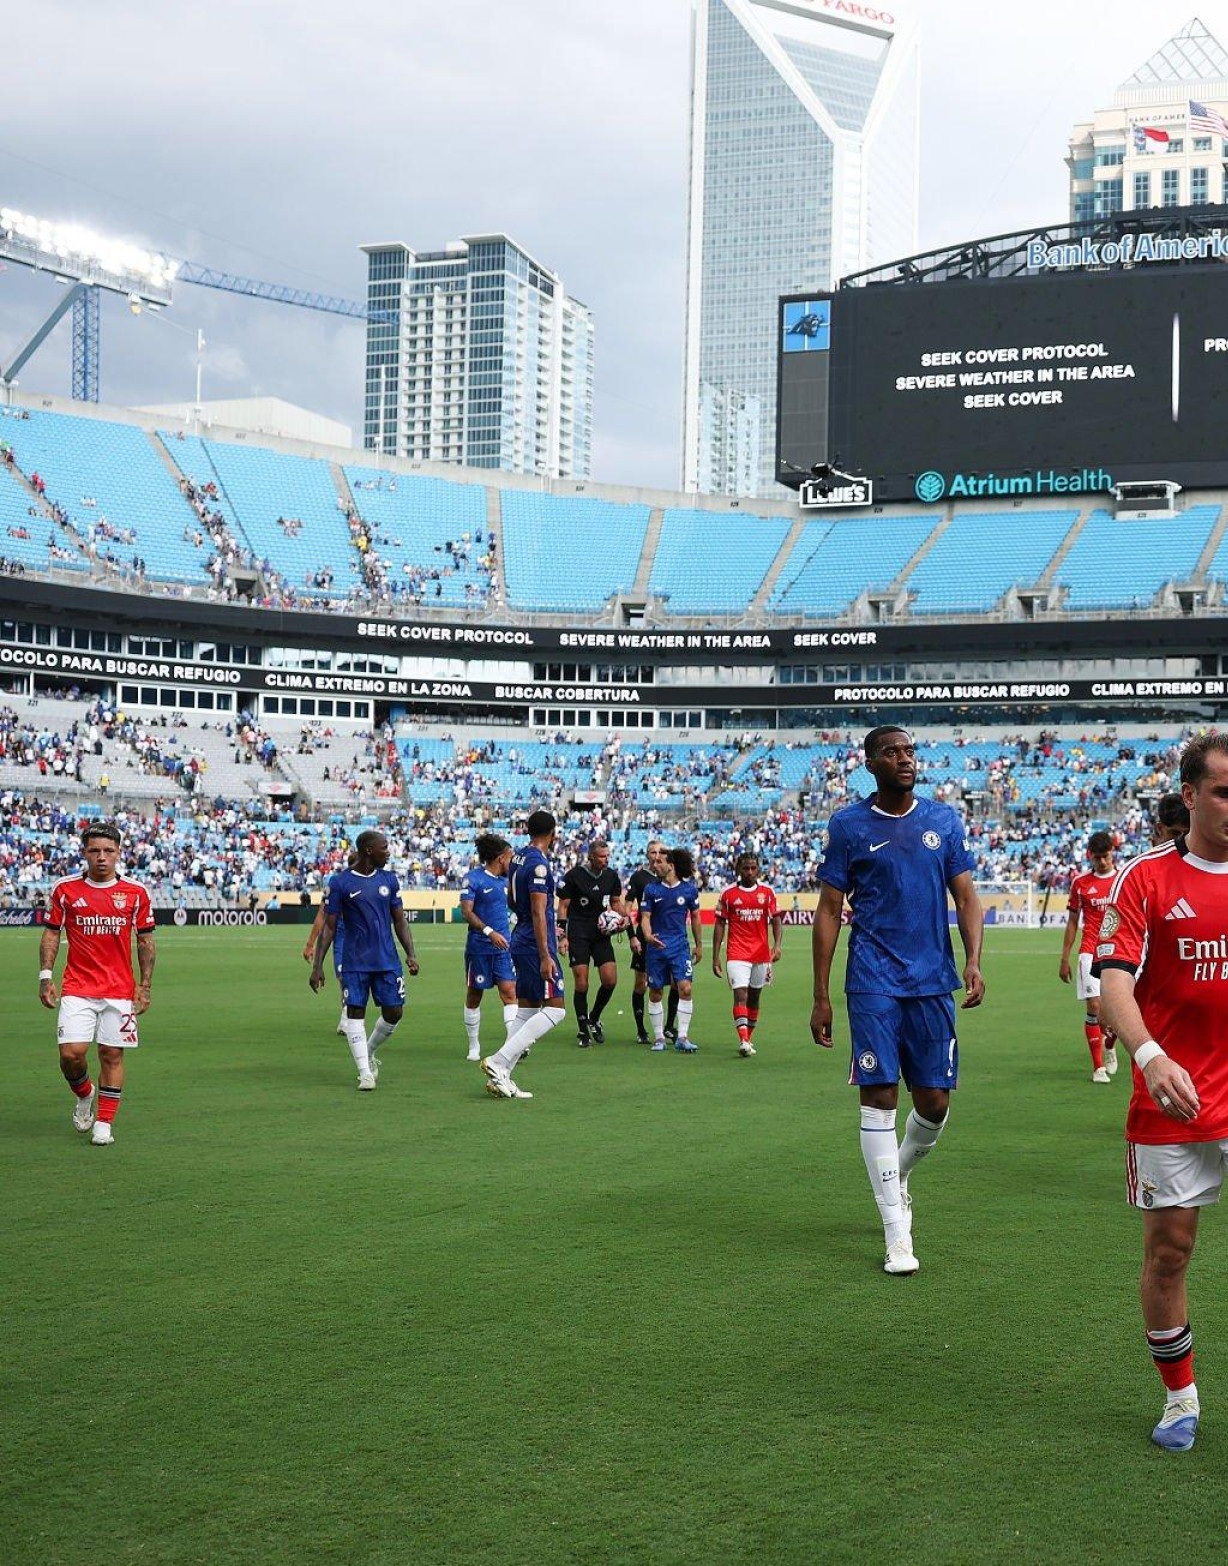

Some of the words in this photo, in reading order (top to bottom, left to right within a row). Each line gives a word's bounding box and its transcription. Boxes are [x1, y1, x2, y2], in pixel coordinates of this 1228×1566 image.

[1027, 234, 1100, 268] Bank
[1101, 233, 1132, 261] of
[921, 352, 961, 366] SEEK
[966, 348, 1019, 363] COVER
[1022, 343, 1108, 360] PROTOCOL
[896, 374, 956, 390] SEVERE
[959, 370, 1034, 386] WEATHER
[1038, 369, 1053, 382] IN
[1057, 367, 1088, 380] THE
[1091, 365, 1135, 379] AREA
[964, 394, 1005, 408] SEEK
[1009, 391, 1063, 406] COVER
[949, 474, 1033, 497] Atrium
[1036, 468, 1112, 493] Health
[358, 623, 396, 637] SEEK
[401, 626, 451, 640] COVER
[455, 629, 533, 644] PROTOCOL
[560, 634, 614, 646] SEVERE
[618, 635, 684, 647] WEATHER
[688, 636, 700, 647] IN
[704, 636, 730, 647] THE
[733, 636, 770, 647] AREA
[794, 634, 828, 646] SEEK
[831, 632, 876, 645] COVER
[1, 649, 57, 666] OCOLO
[62, 655, 102, 671] PARA
[107, 660, 169, 677] BUSCAR
[174, 666, 240, 683] REFUGIO
[265, 674, 312, 688] CLIMA
[316, 677, 385, 692] EXTREMO
[389, 682, 407, 693] EN
[412, 683, 429, 695] LA
[432, 684, 471, 696] ZONA
[496, 686, 552, 699] BUSCAR
[556, 688, 639, 701] COBERTURA
[835, 688, 913, 700] PROTOCOLO
[917, 687, 951, 698] PARA
[954, 686, 1008, 698] BUSCAR
[1011, 684, 1069, 696] REFUGIO
[1092, 684, 1134, 695] CLIMA
[1136, 682, 1202, 695] EXTREMO
[1205, 682, 1224, 693] EN
[76, 914, 127, 925] Emirates
[198, 909, 267, 925] motorola
[1194, 962, 1217, 981] FLY
